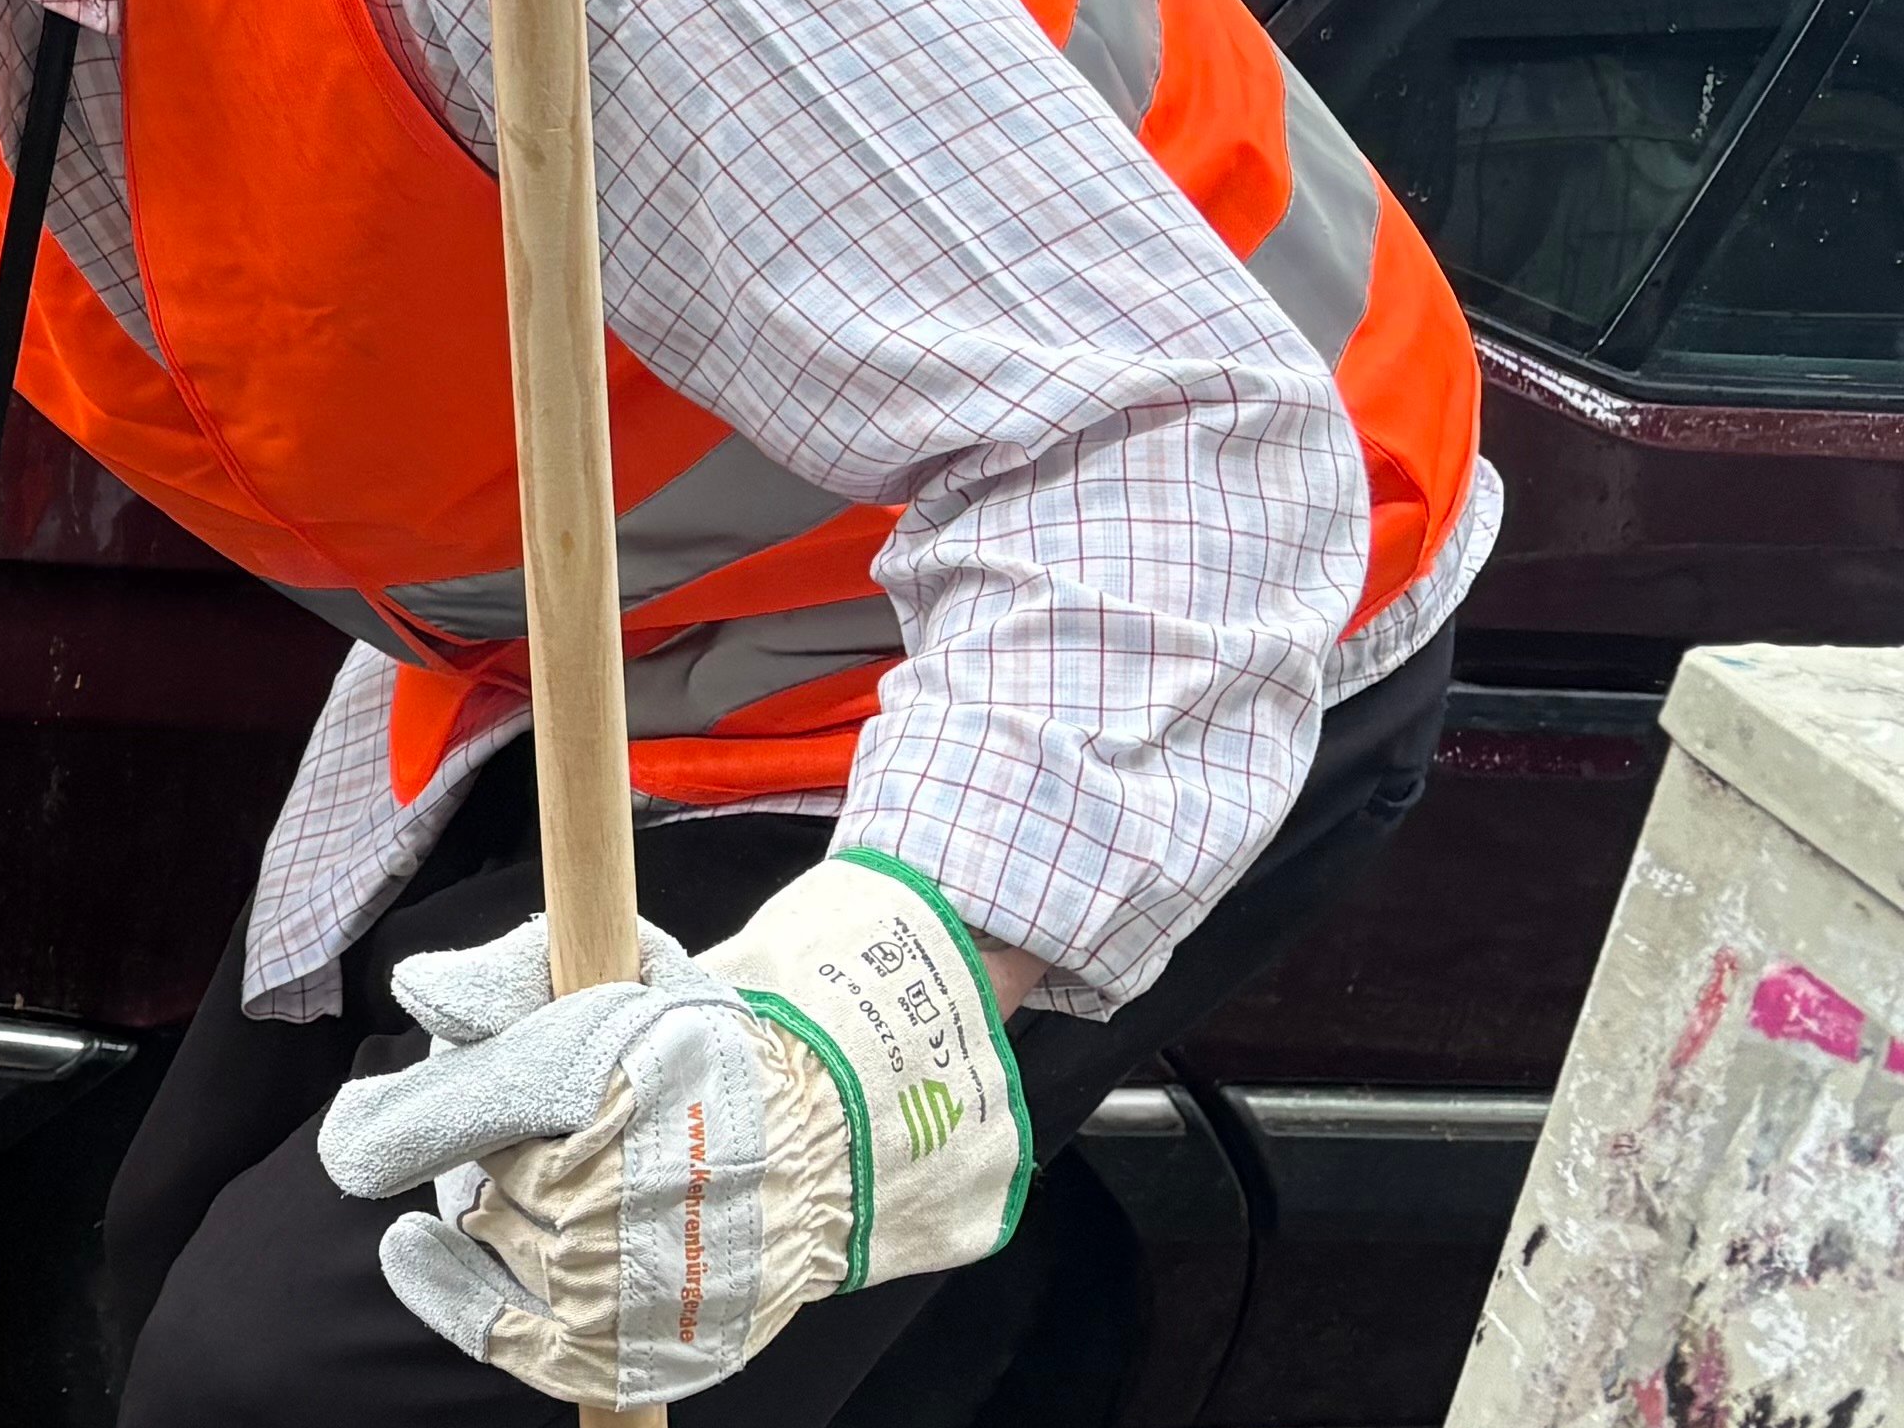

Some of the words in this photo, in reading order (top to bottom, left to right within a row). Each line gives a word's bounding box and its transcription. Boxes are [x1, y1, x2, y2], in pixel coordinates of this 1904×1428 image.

[818, 963, 846, 984] 10
[859, 1000, 895, 1045] 2300
[888, 1045, 904, 1073] GS
